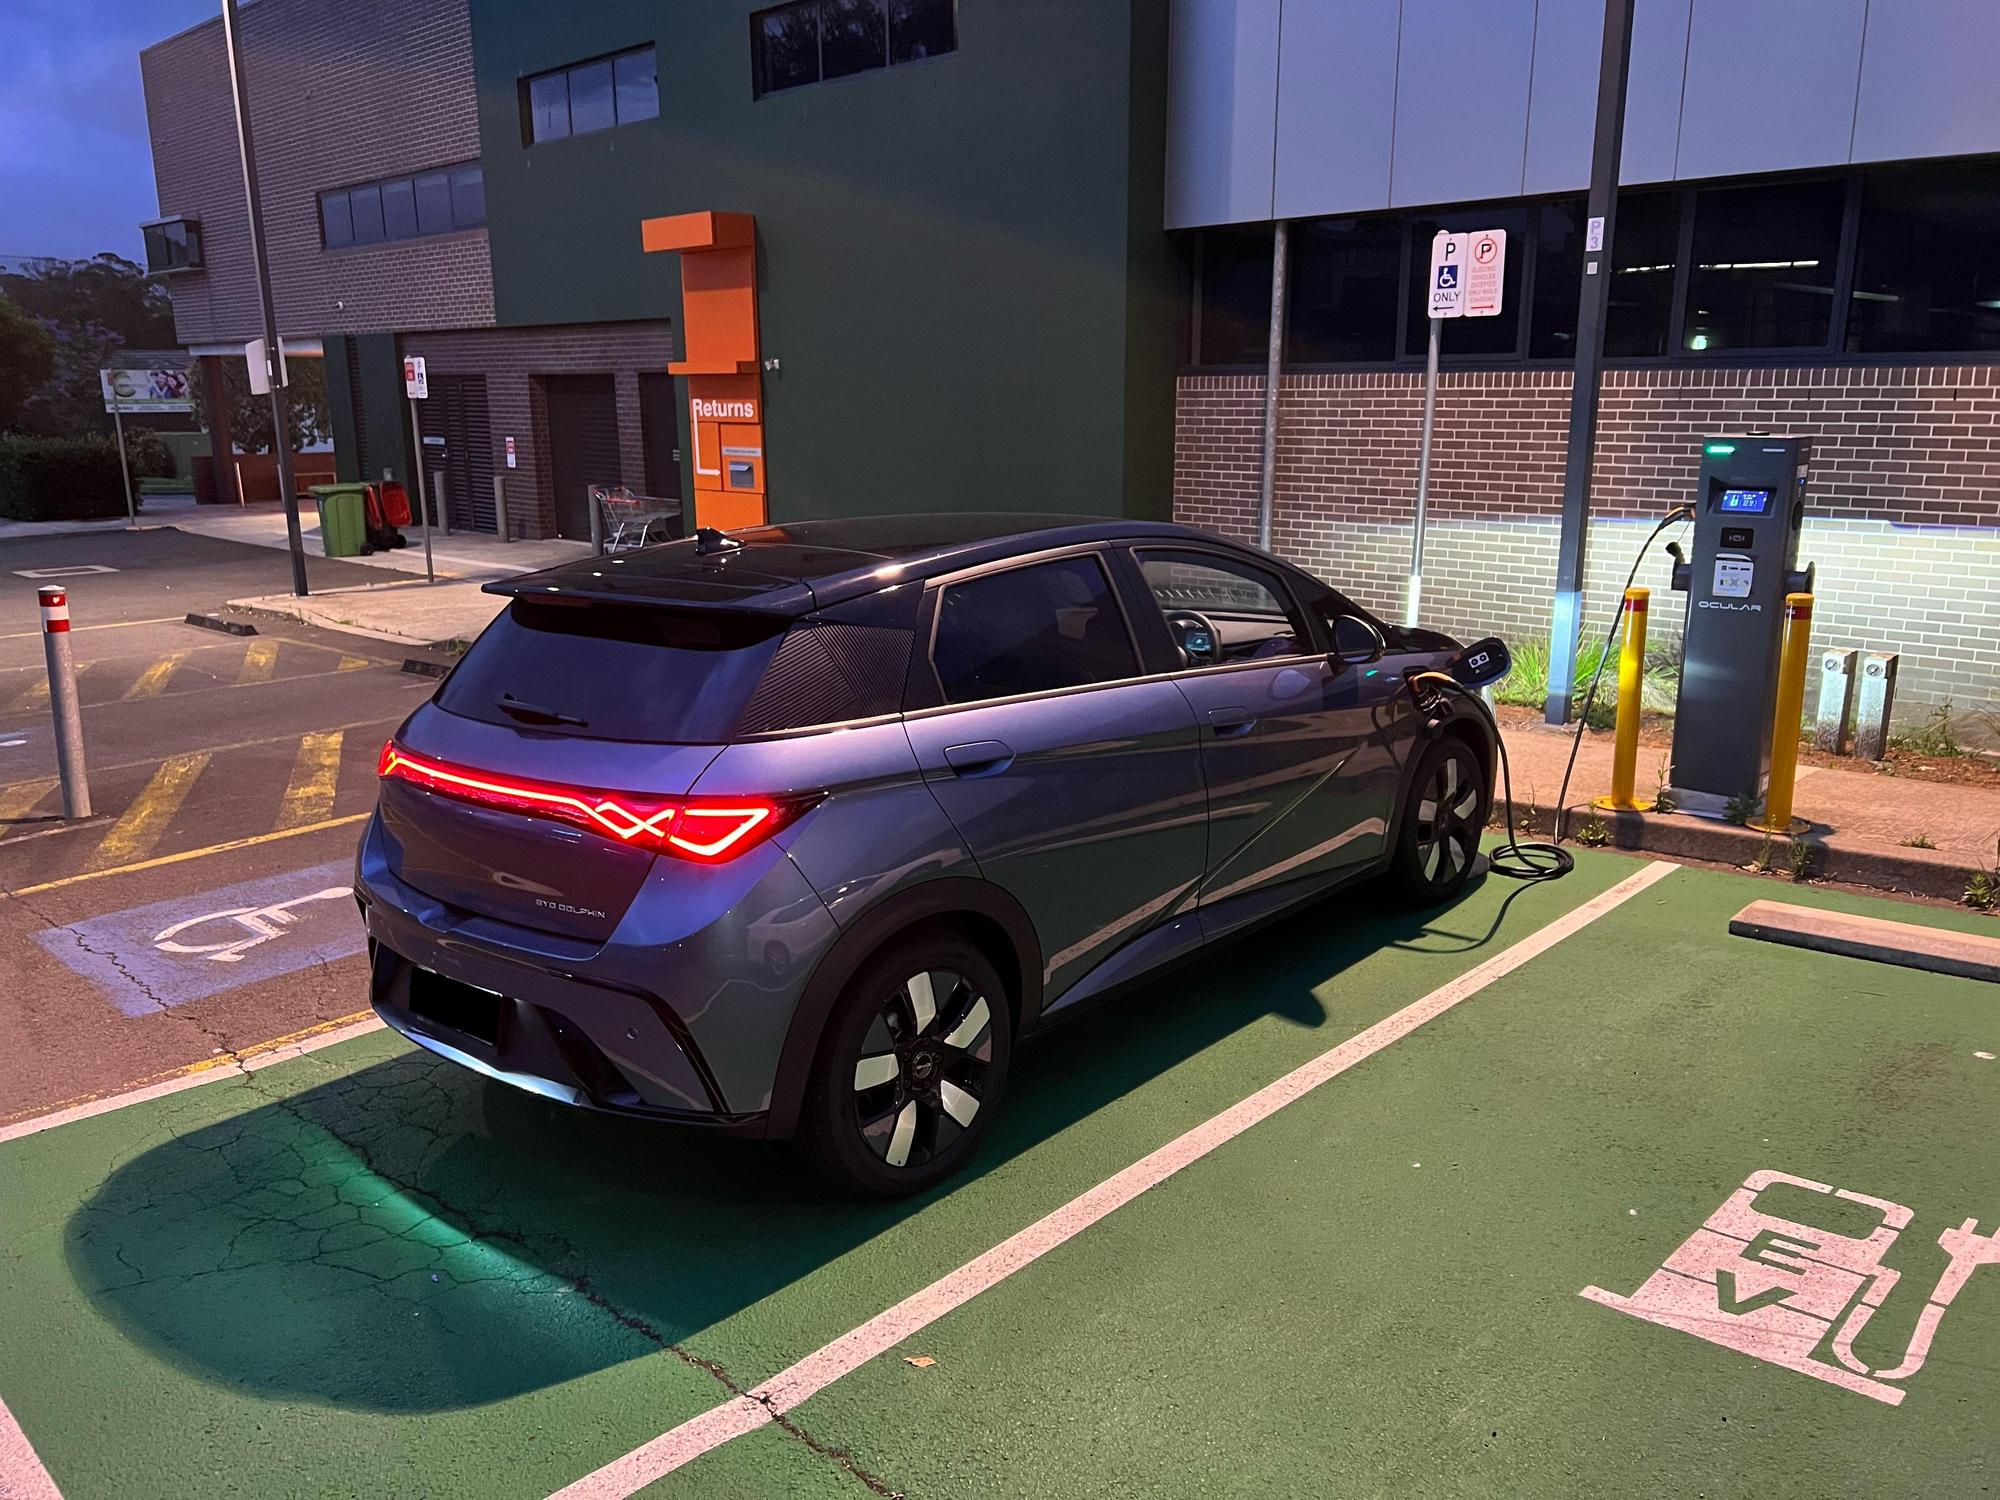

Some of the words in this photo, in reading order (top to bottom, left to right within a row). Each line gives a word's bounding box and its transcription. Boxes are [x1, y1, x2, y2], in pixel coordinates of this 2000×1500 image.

[1591, 220, 1601, 235] P
[1590, 236, 1599, 250] 3
[1445, 242, 1457, 262] P
[1433, 290, 1461, 302] ONLY
[692, 398, 754, 418] Returns
[1698, 600, 1762, 612] OCULAR
[535, 898, 557, 910] BYD
[558, 903, 606, 919] DOLPHIN
